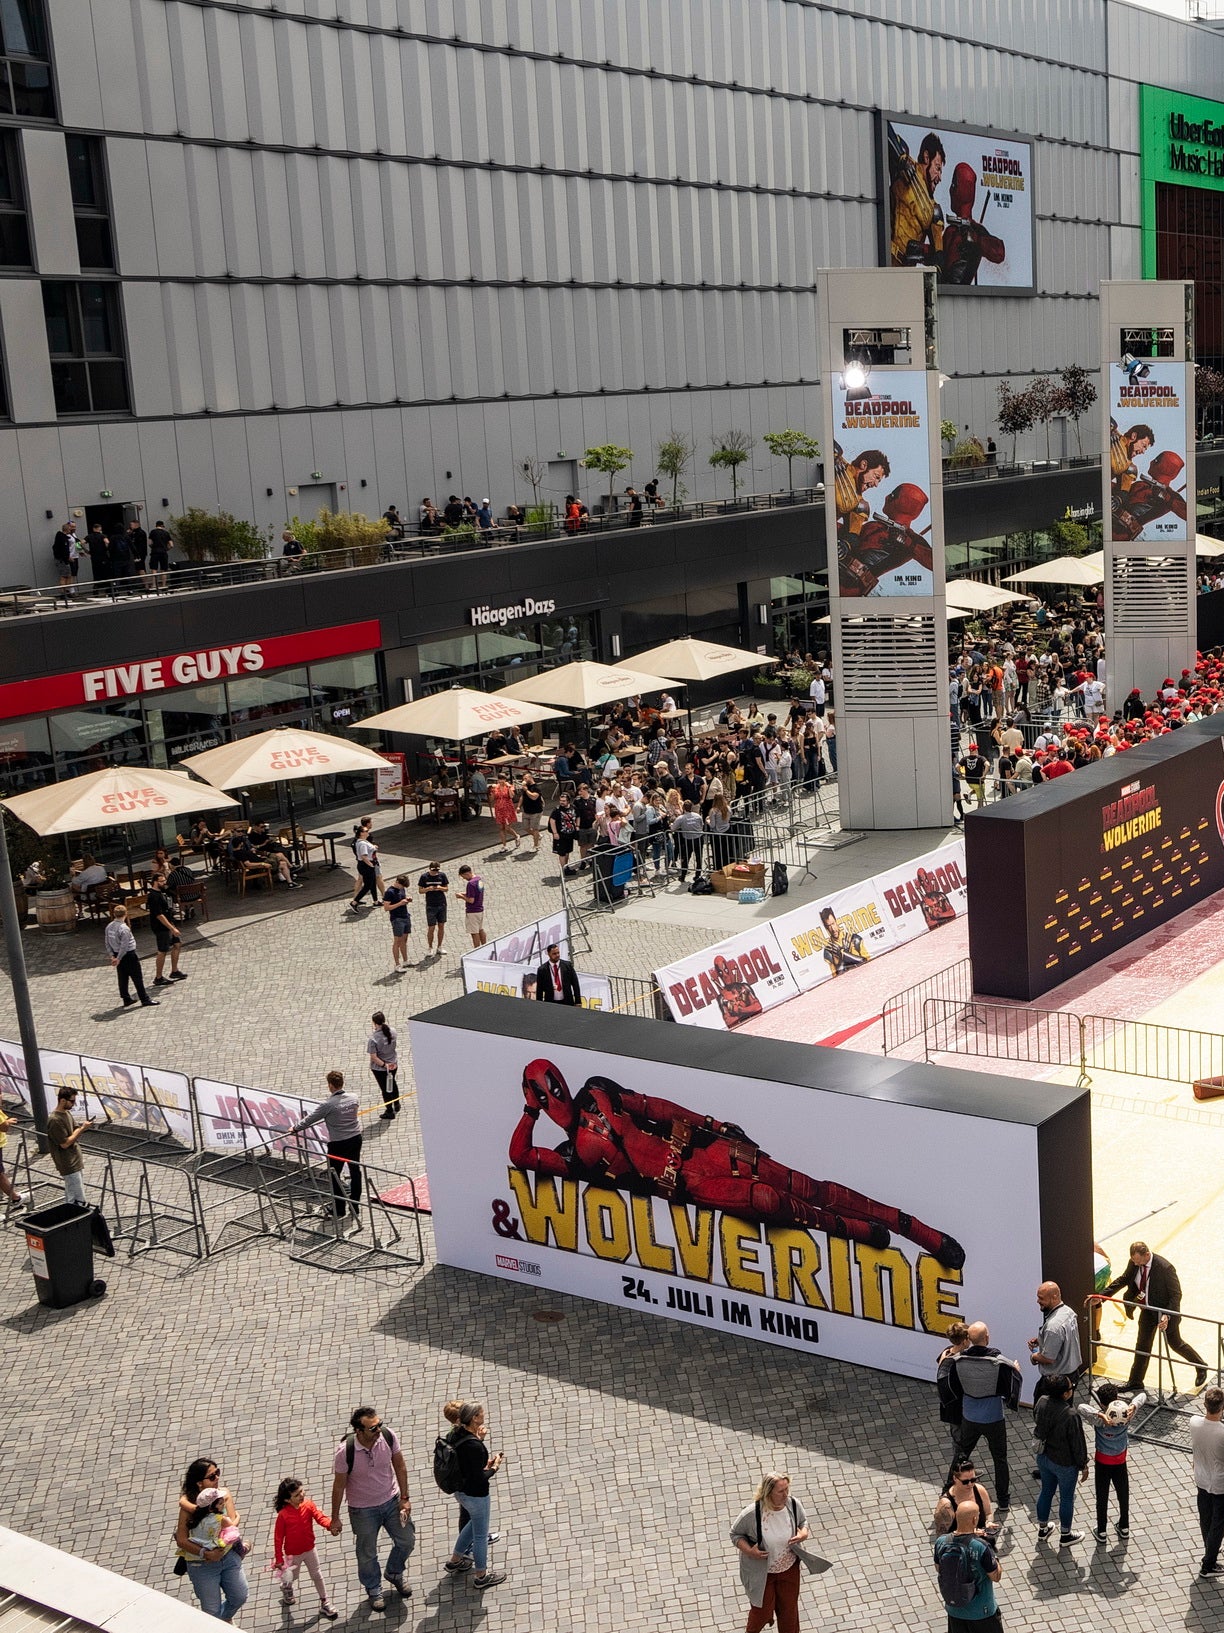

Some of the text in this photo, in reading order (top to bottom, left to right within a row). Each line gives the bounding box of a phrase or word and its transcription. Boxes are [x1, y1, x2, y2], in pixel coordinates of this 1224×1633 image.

[982, 155, 1022, 176] DEADPOOL
[1119, 385, 1177, 398] DEADPOOL
[844, 401, 916, 416] DEADPOOL
[82, 644, 264, 701] FIVE GUYS
[333, 708, 351, 718] OPEN
[472, 702, 508, 714] FIVE
[479, 708, 521, 722] GUYS
[271, 746, 320, 761] FIVE
[270, 755, 330, 771] GUYS
[102, 788, 157, 804] FIVE
[101, 796, 169, 814] GUYS
[1102, 784, 1159, 831] DEADPOOL
[791, 902, 882, 962] &WOLERINE
[519, 1260, 541, 1276] STUDIOS
[621, 1275, 819, 1343] 24. JULI IM KINO
